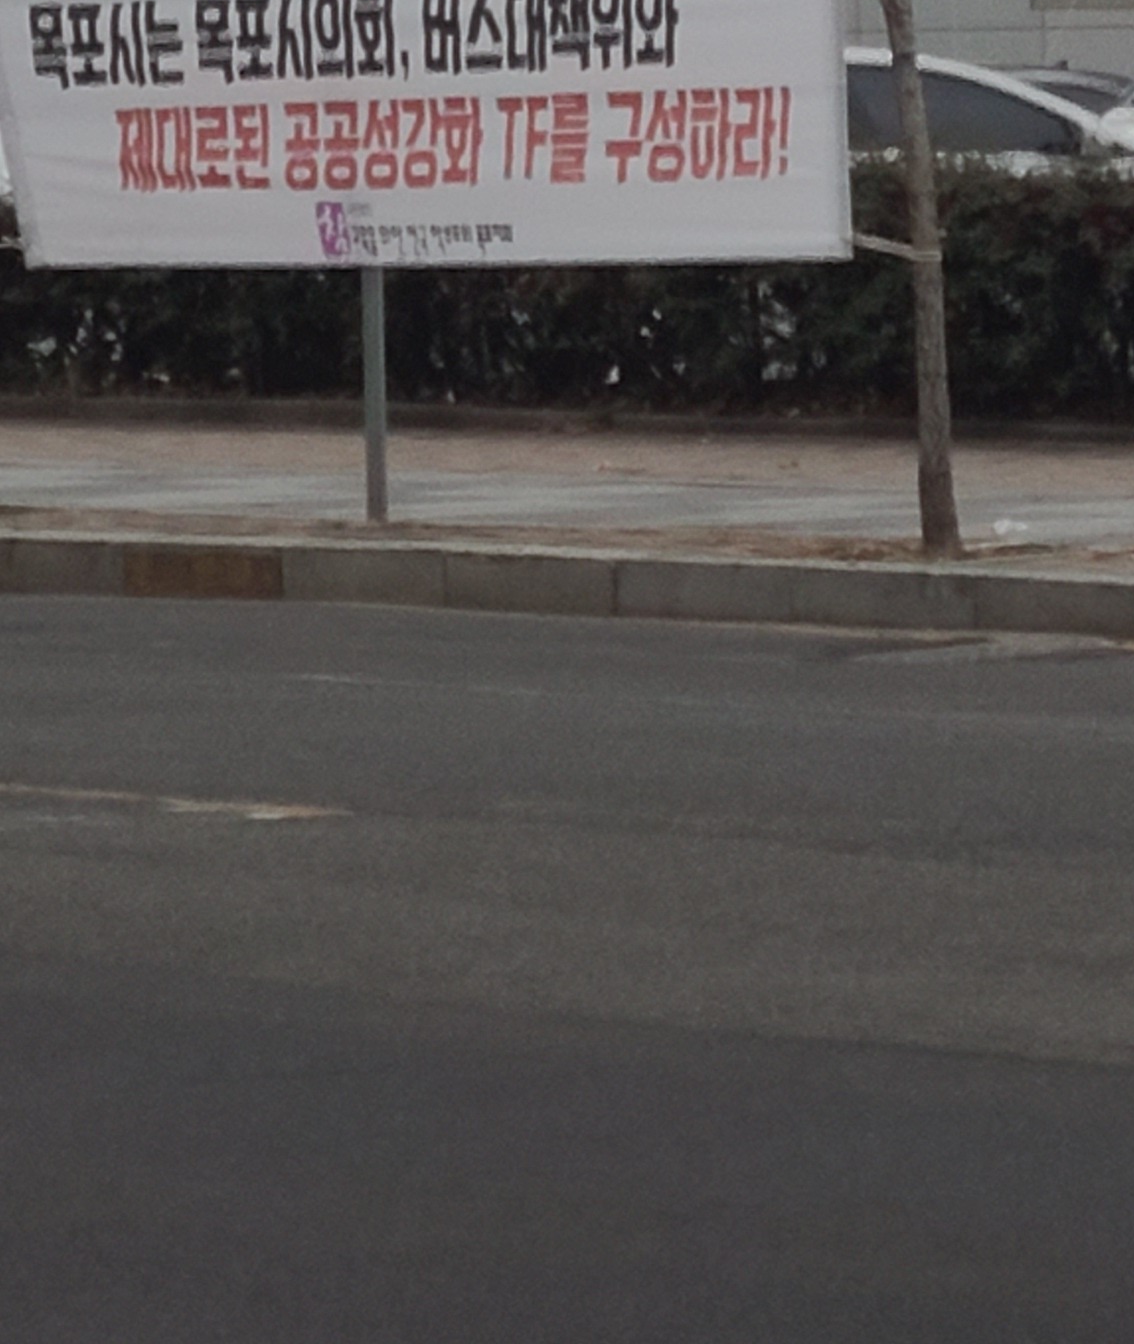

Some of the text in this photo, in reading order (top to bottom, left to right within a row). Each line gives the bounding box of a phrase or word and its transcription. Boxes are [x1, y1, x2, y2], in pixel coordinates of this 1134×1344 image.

[29, 0, 184, 90] 목포시는
[115, 85, 792, 192] 제대로된 공공성강화 TF를 구성하라!
